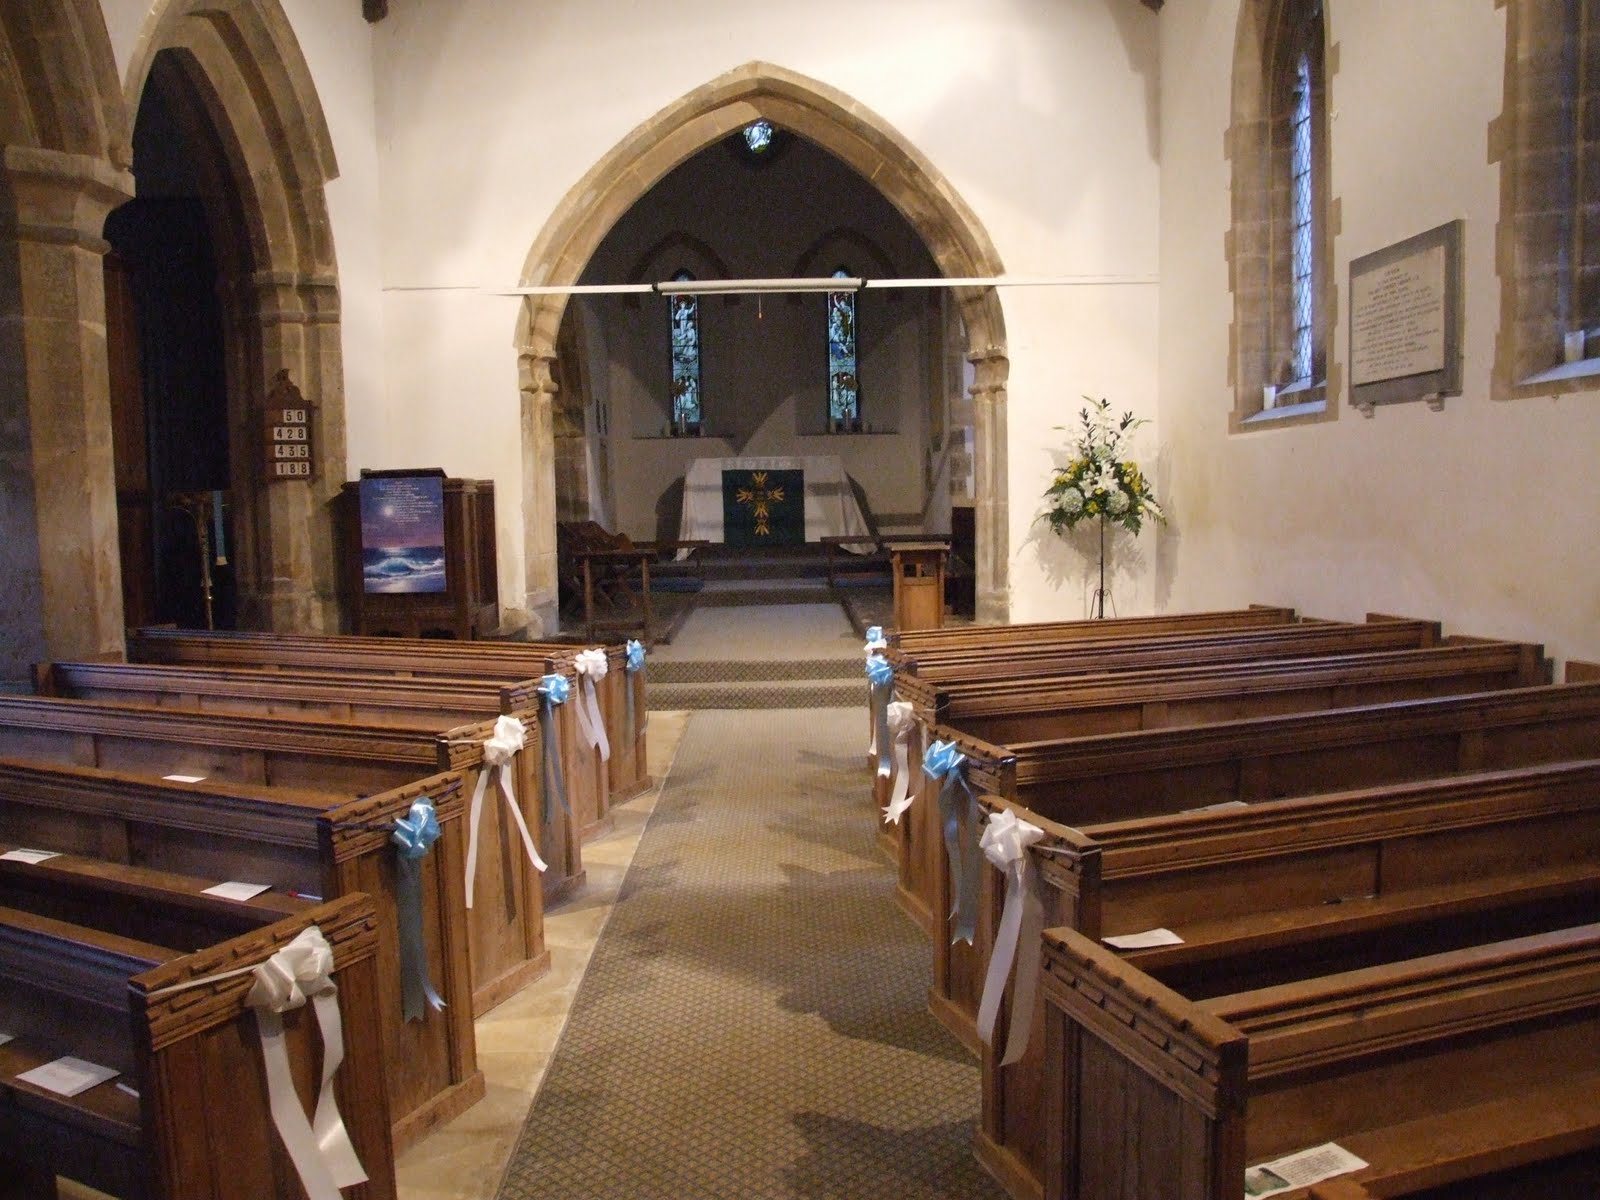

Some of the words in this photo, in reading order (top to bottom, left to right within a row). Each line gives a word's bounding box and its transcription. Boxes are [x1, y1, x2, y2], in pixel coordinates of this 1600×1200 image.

[286, 411, 303, 422] 50
[276, 428, 304, 439] 428
[277, 445, 306, 457] 435
[279, 463, 307, 474] 188
